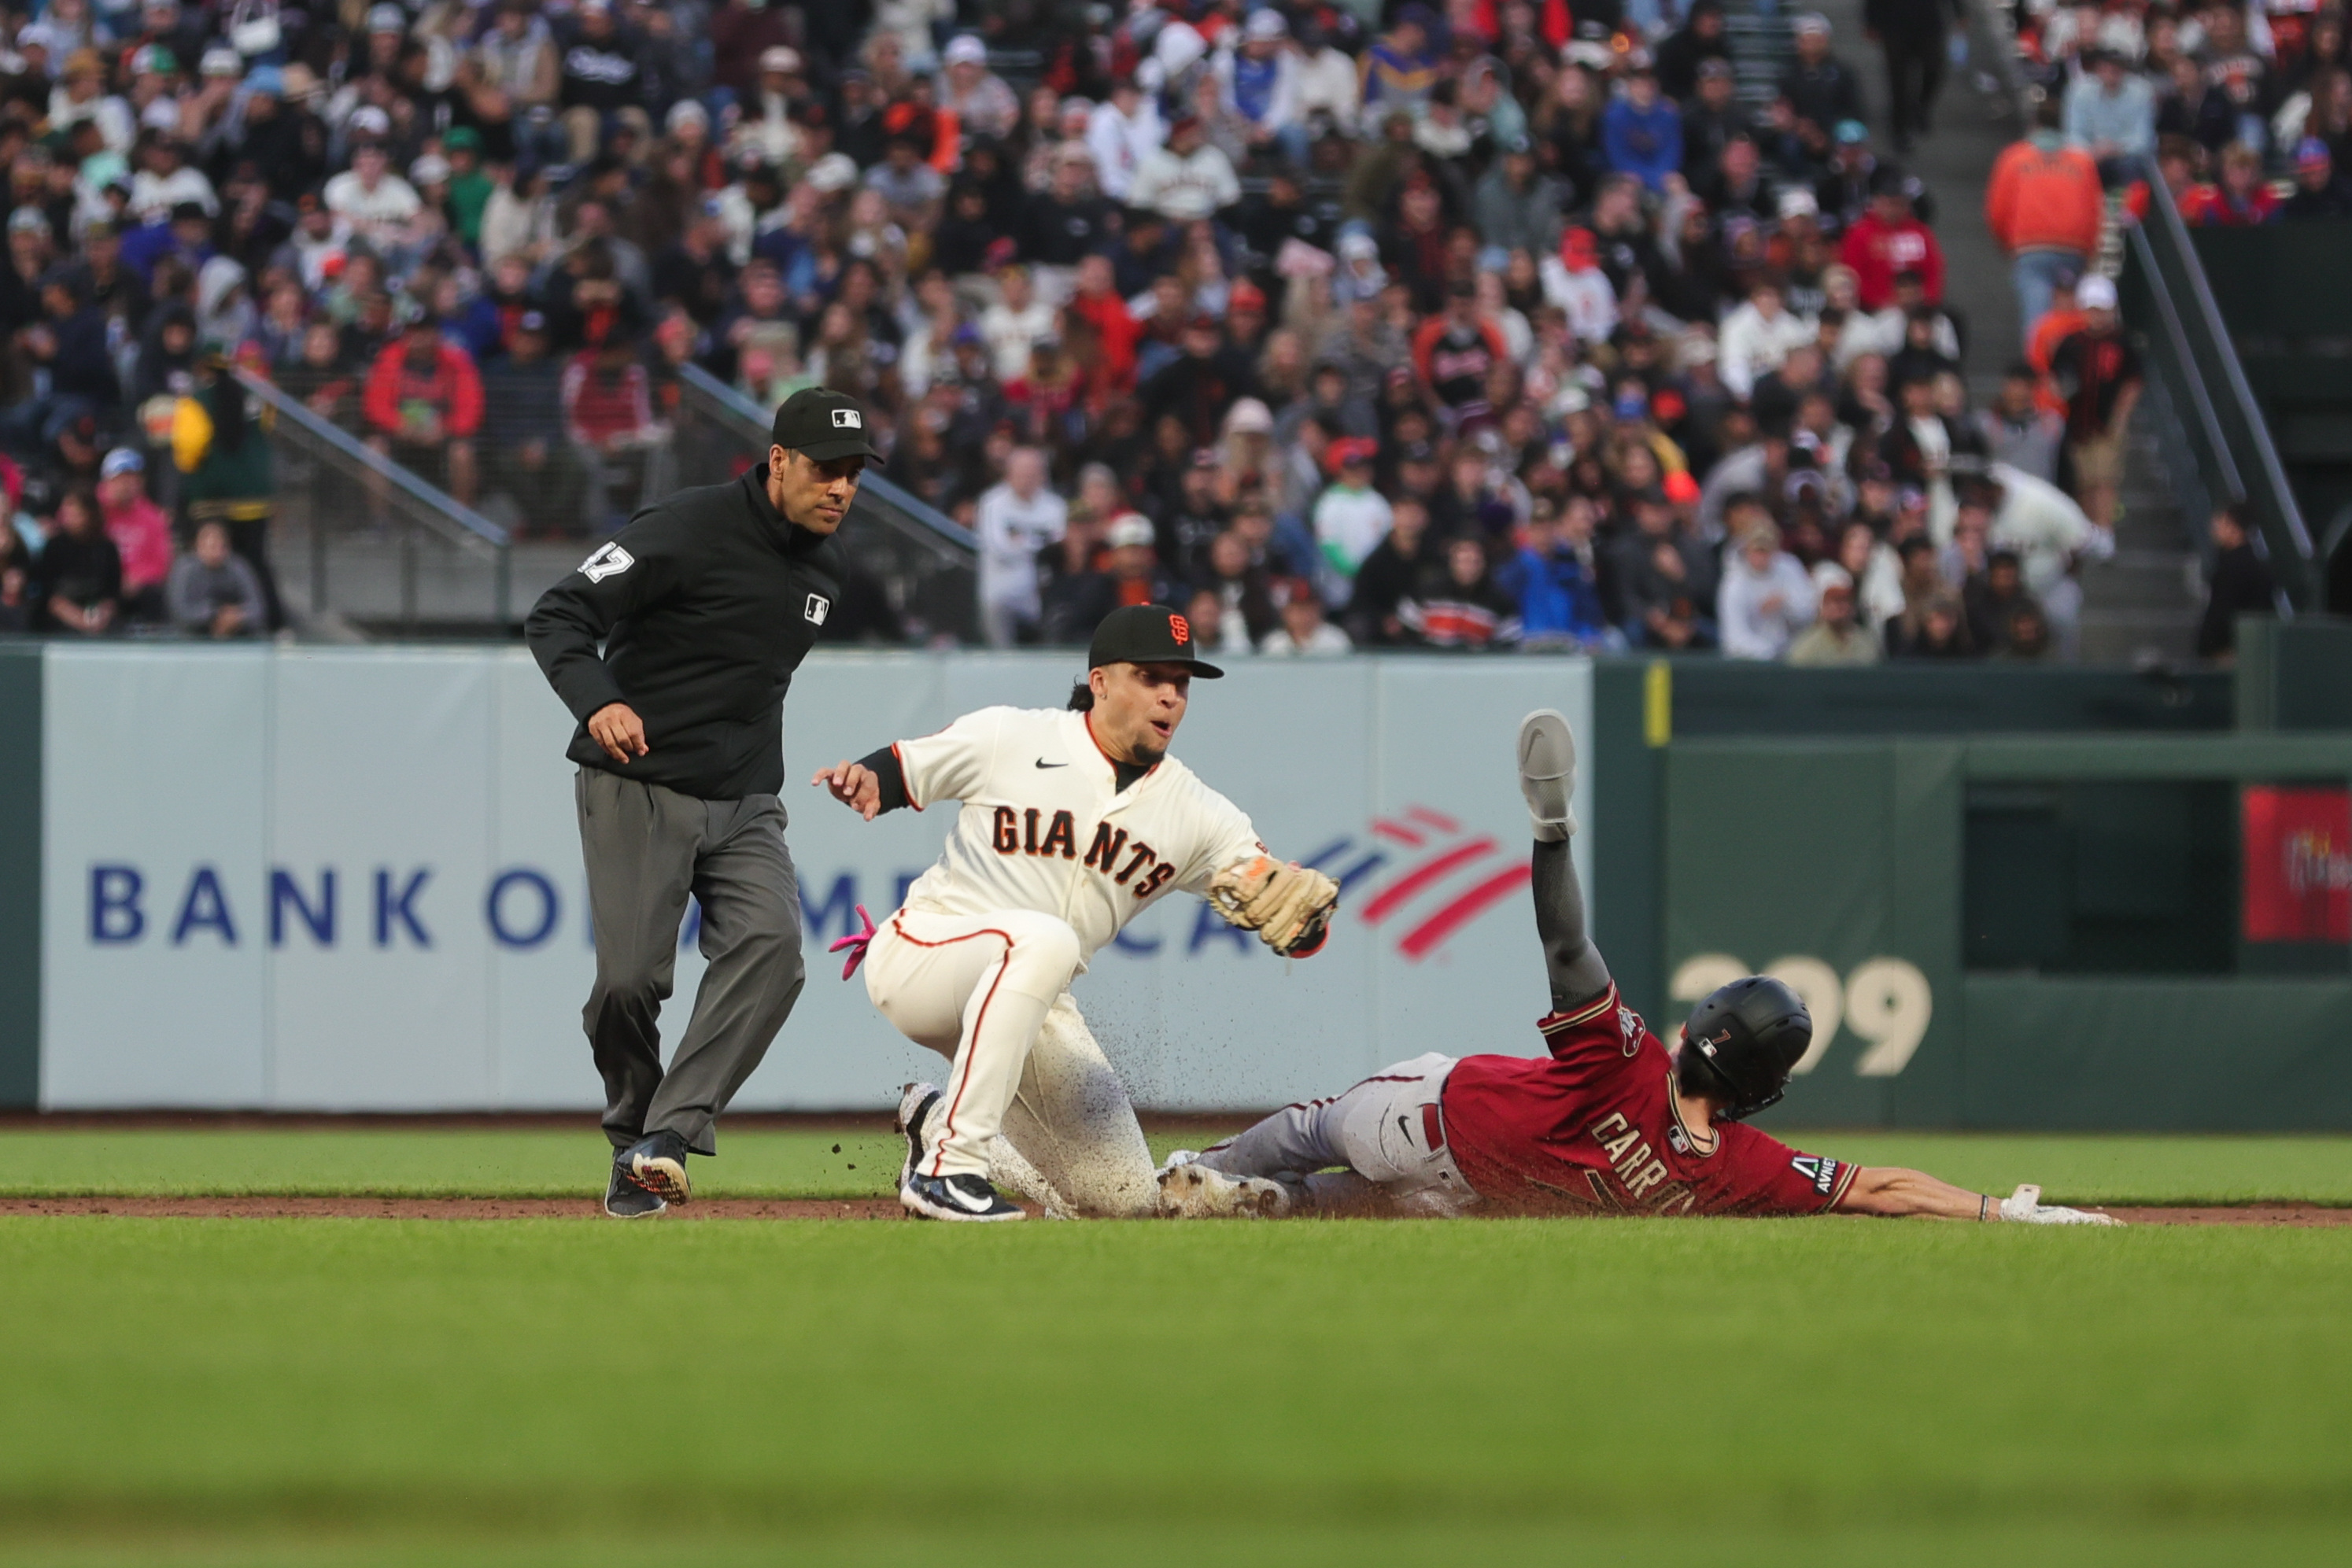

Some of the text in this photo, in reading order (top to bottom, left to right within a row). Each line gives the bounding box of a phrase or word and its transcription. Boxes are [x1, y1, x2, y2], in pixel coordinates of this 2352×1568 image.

[992, 806, 1176, 899] GIANTS
[90, 867, 433, 946] BANK
[485, 867, 599, 948] O
[1712, 1028, 1731, 1044] 7
[1817, 1157, 1836, 1193] AVNE
